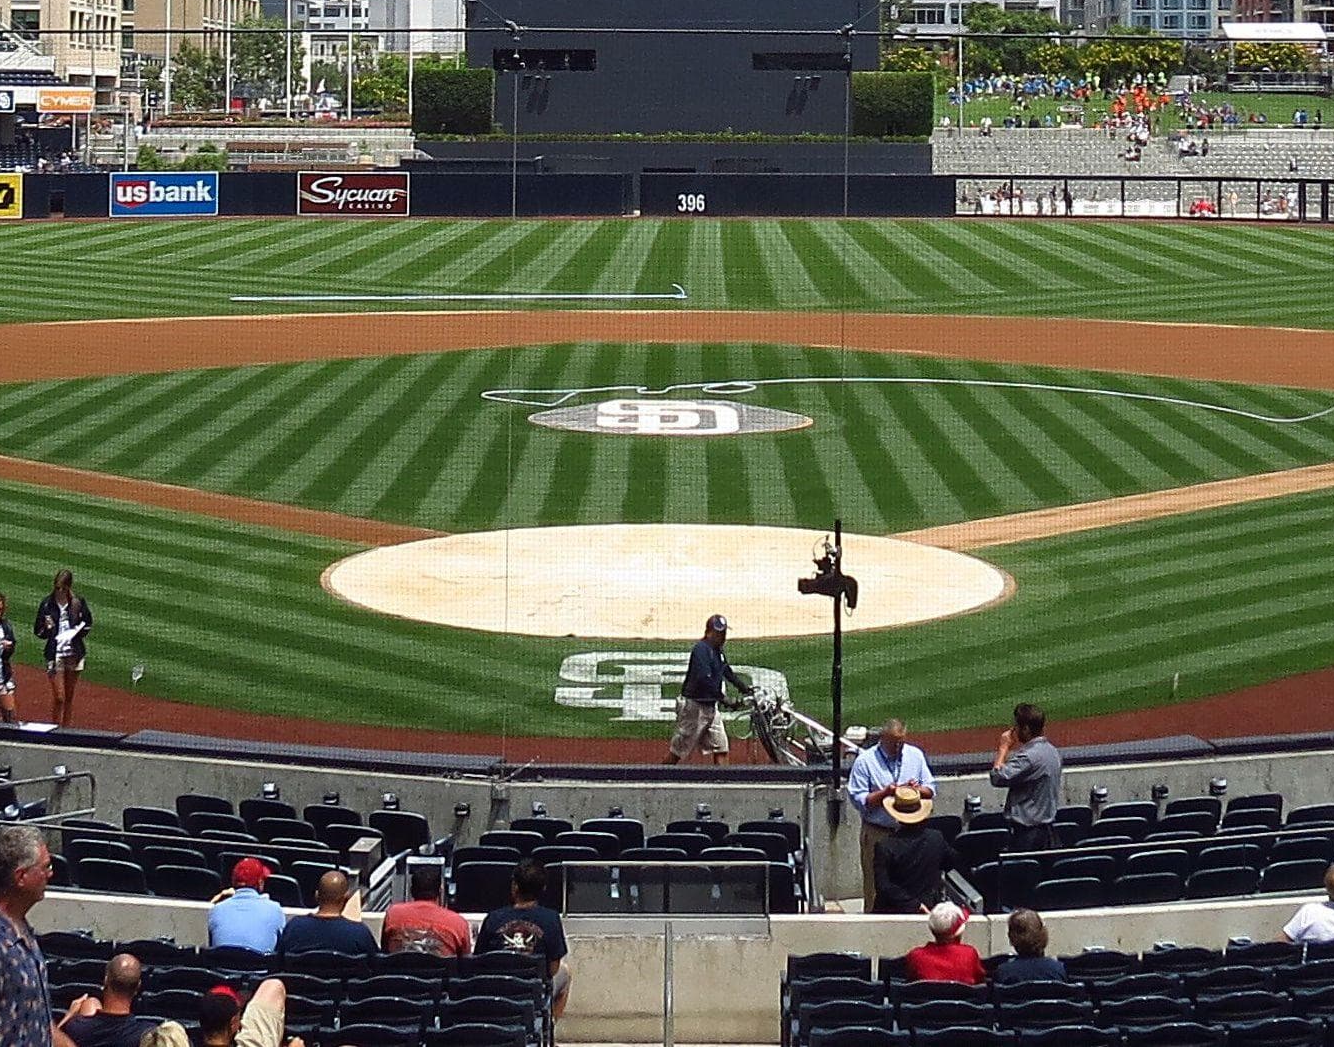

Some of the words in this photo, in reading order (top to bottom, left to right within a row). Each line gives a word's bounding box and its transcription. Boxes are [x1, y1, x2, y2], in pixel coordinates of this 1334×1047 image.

[39, 94, 93, 108] CYMER
[116, 179, 214, 203] usbank
[310, 176, 400, 210] Sycuan
[677, 193, 706, 212] 396
